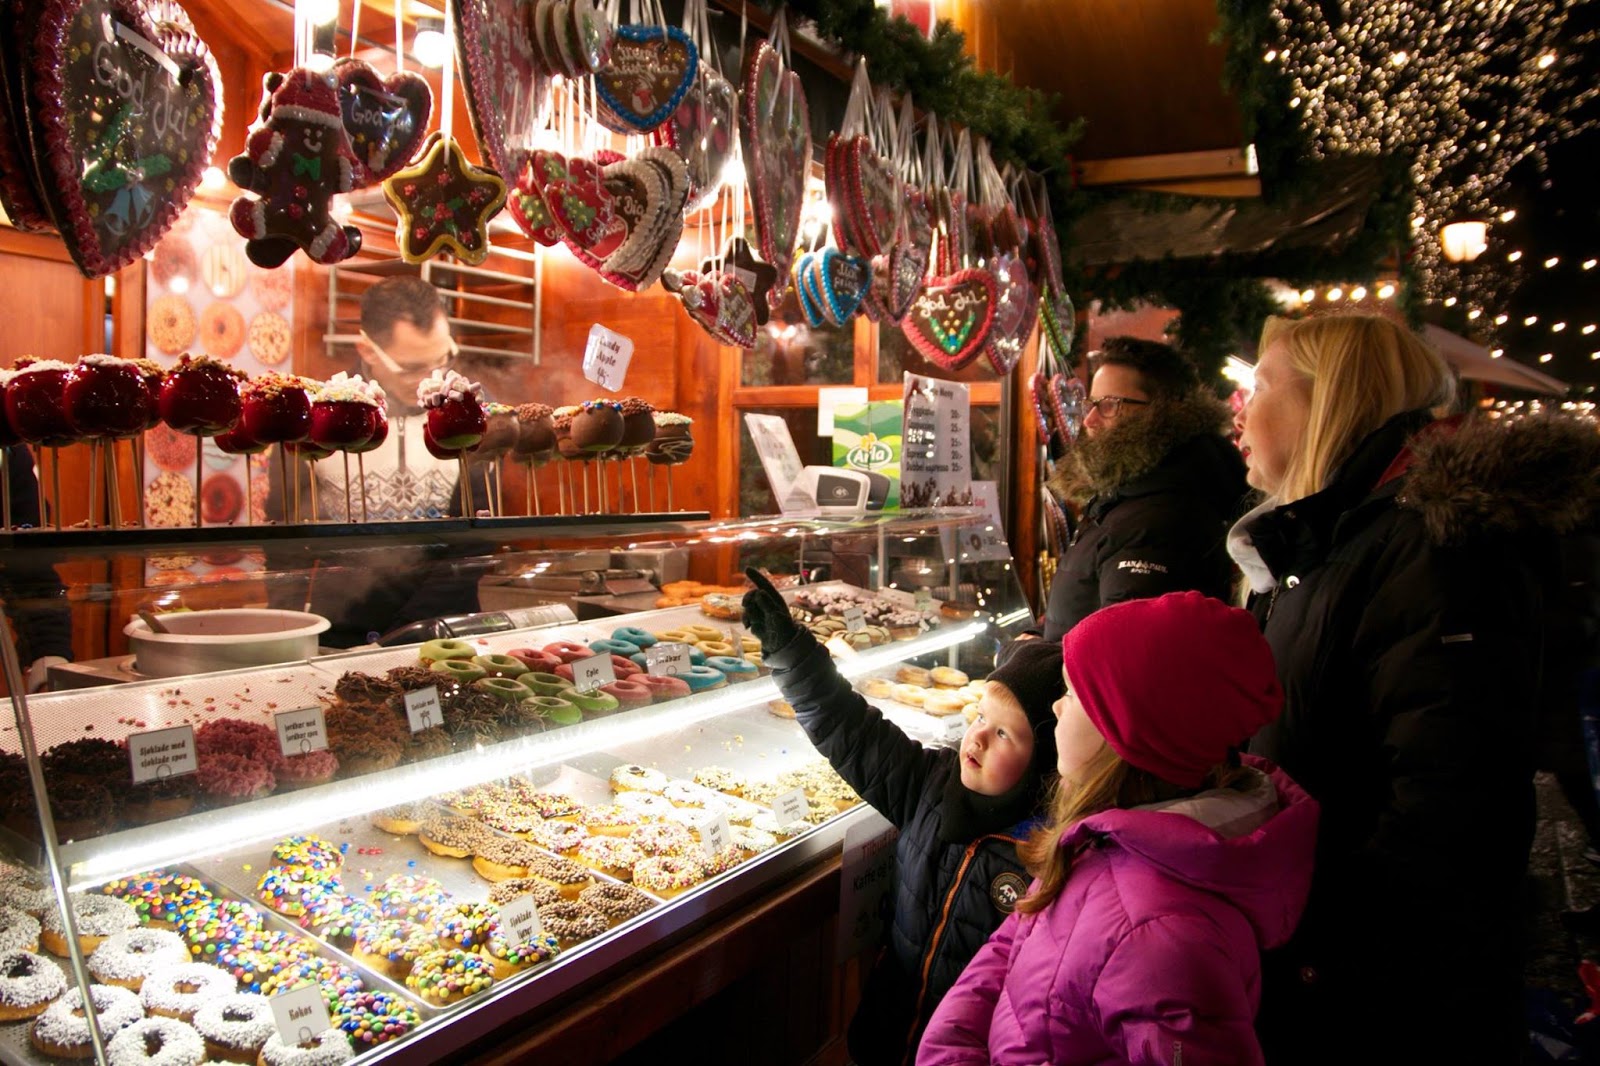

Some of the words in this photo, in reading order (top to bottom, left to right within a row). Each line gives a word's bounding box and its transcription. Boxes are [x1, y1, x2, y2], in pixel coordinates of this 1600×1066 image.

[93, 41, 147, 116] God
[153, 82, 188, 141] Jul
[351, 98, 383, 126] God
[915, 294, 950, 318] God
[950, 289, 983, 311] Jul
[595, 350, 617, 367] Apple
[853, 446, 885, 464] Arla
[585, 667, 599, 678] Eple
[171, 740, 186, 750] med
[288, 1005, 312, 1021] Kokos
